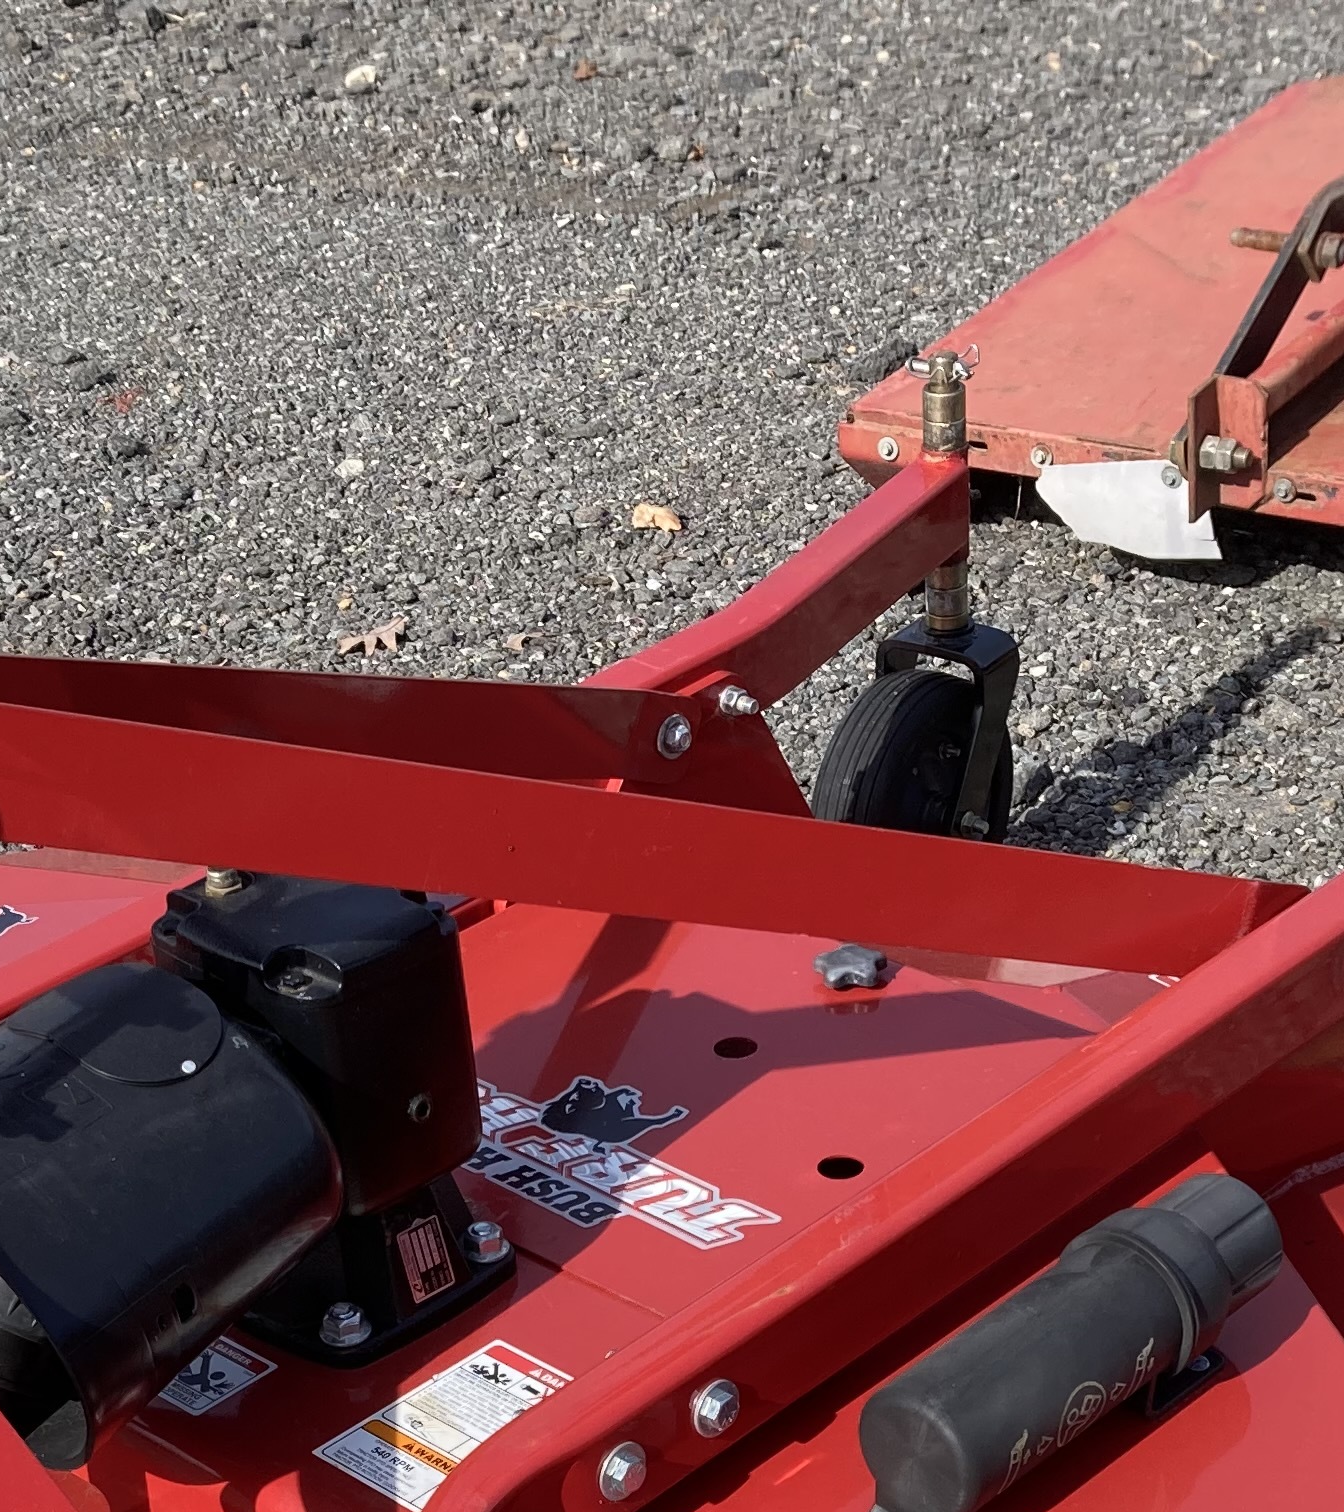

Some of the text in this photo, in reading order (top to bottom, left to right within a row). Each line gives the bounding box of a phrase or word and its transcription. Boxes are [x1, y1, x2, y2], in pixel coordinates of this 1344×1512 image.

[492, 1164, 622, 1225] BUSH
[215, 1343, 253, 1365] DANGER
[369, 1445, 391, 1460] 540
[388, 1455, 414, 1473] RPM
[414, 1446, 453, 1473] WARNI
